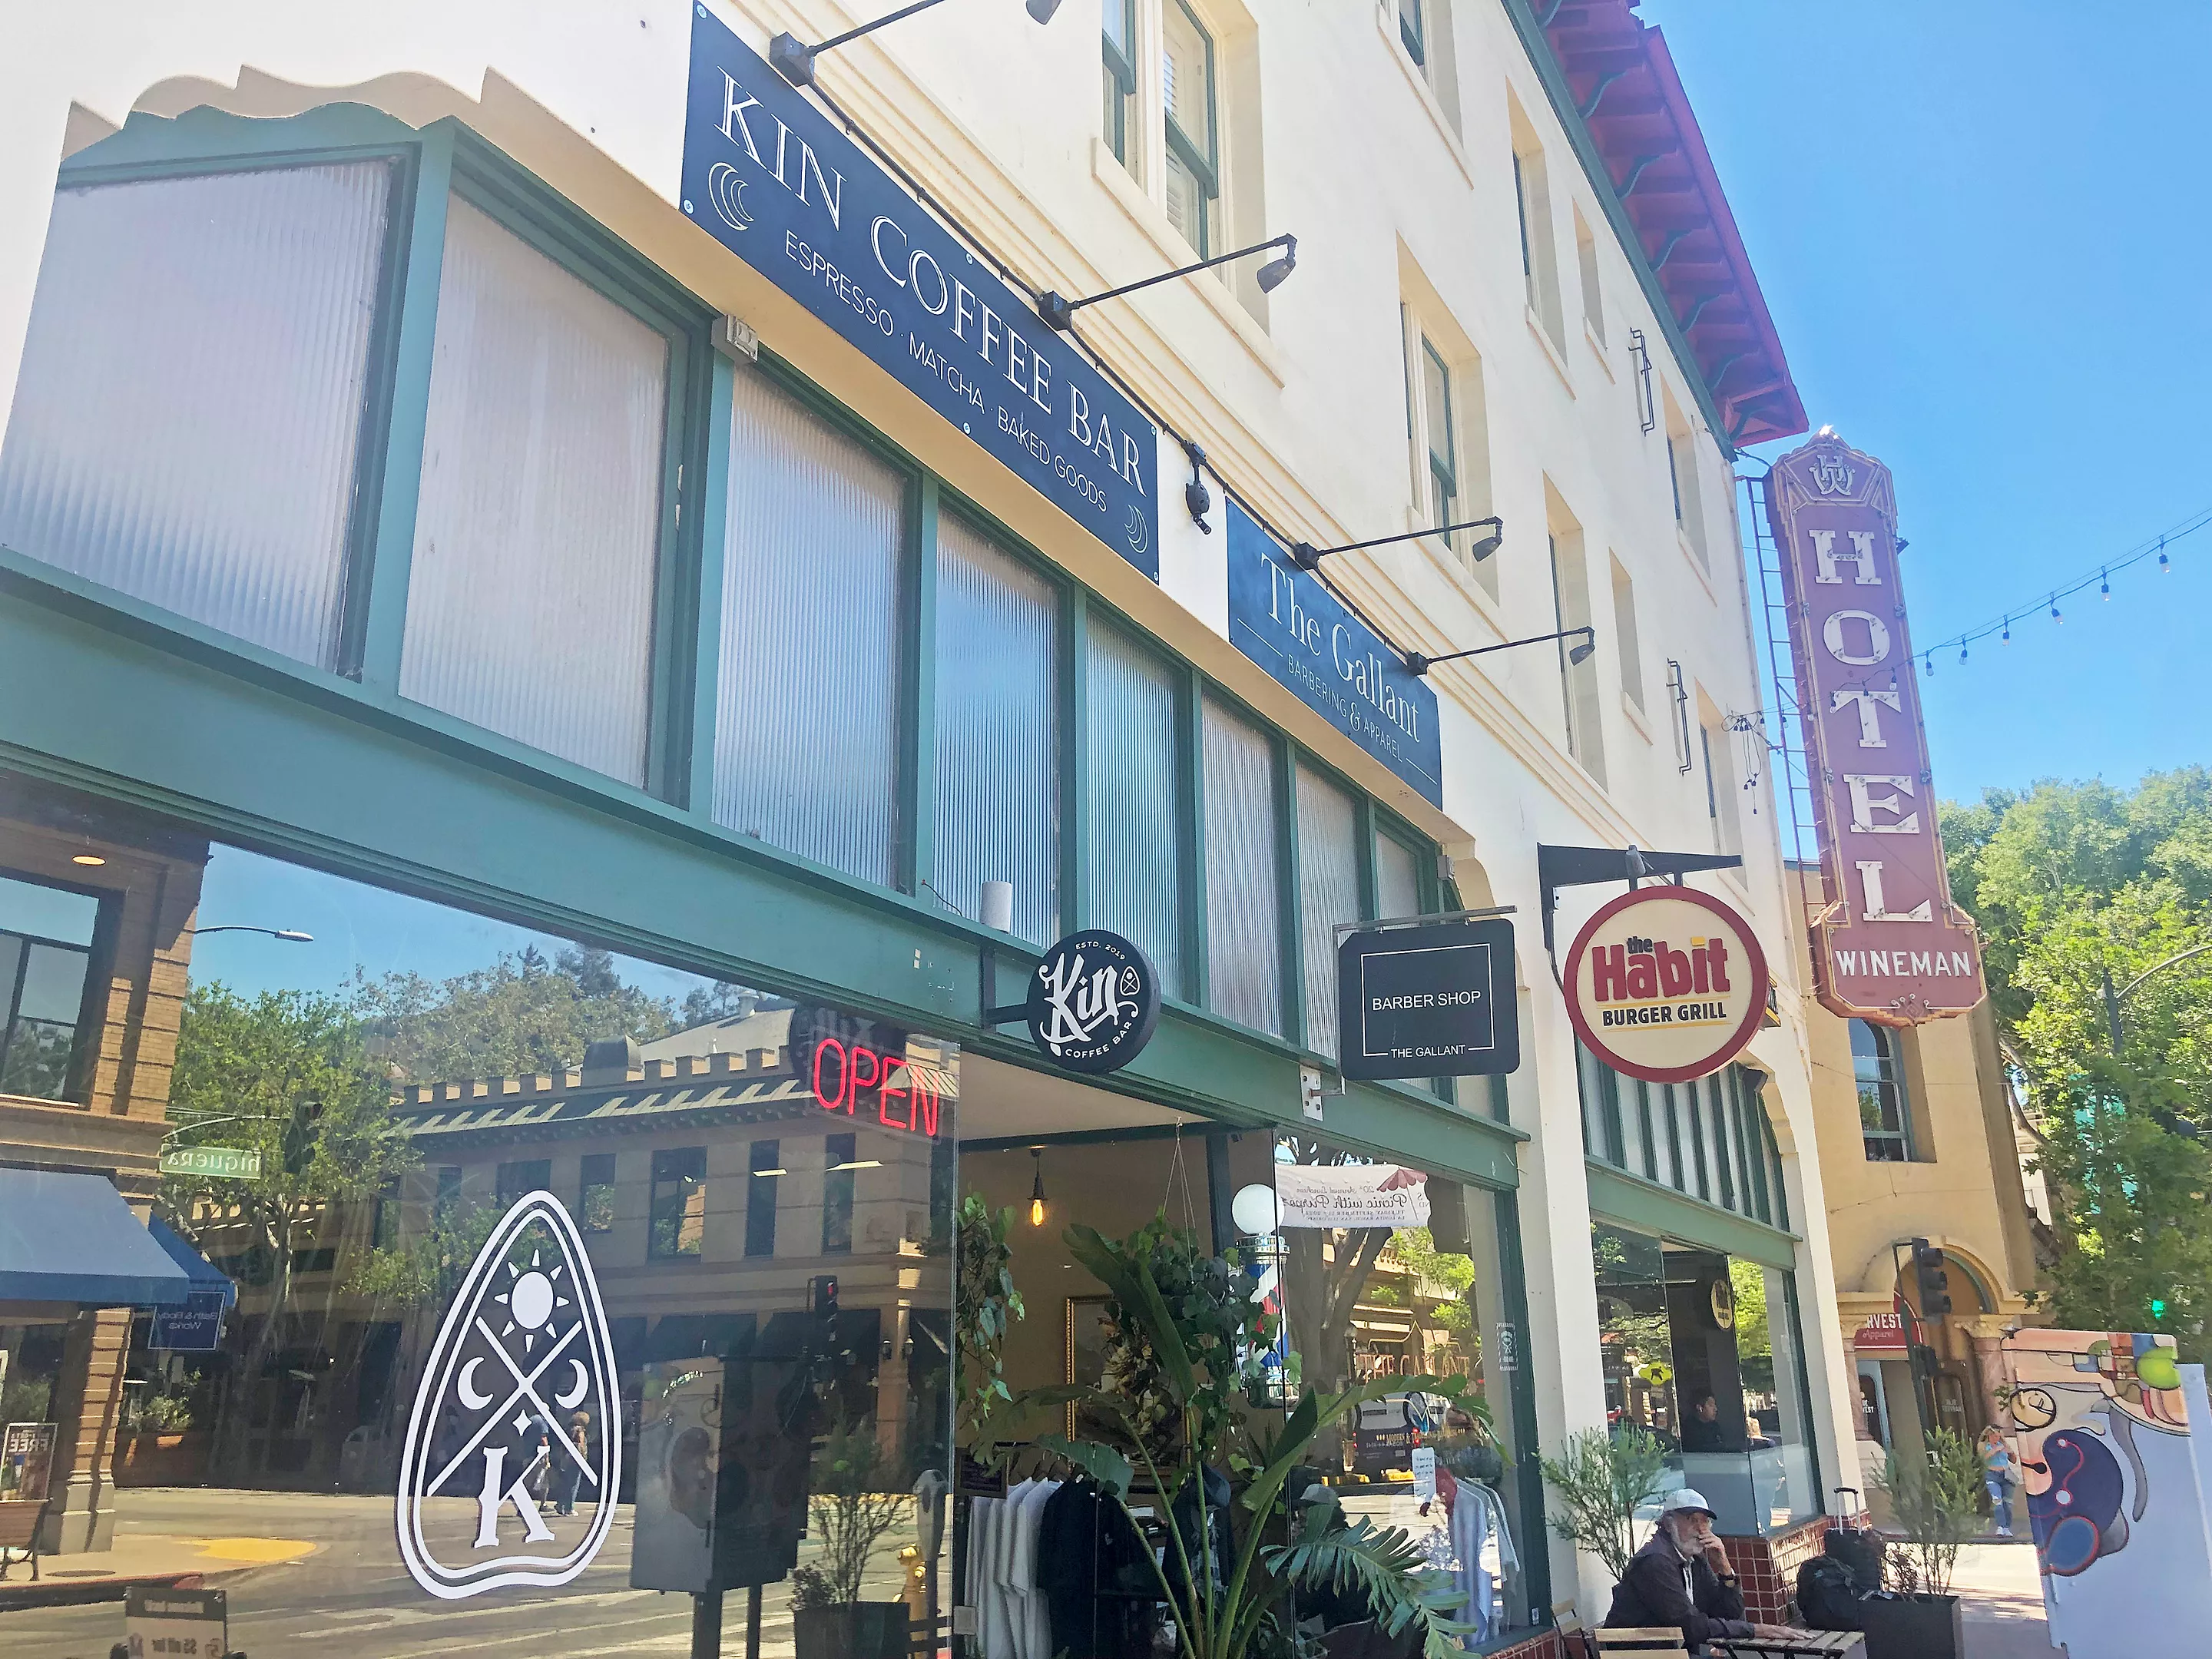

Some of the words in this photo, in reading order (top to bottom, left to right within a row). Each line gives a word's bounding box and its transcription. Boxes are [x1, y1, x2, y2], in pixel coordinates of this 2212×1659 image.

[714, 66, 846, 231] KIN
[870, 215, 1053, 415] COFFEE
[1066, 379, 1147, 498] BAR
[785, 230, 894, 336] ESPRESSO
[909, 332, 985, 415] MATCHA
[998, 405, 1051, 466] BAKED
[1055, 452, 1107, 513] GOODS
[1260, 551, 1322, 657] The
[1332, 623, 1421, 743] Gallant
[1288, 654, 1347, 717] BARBERING
[1350, 701, 1361, 732] &
[1363, 717, 1403, 763] APPAREL
[1809, 529, 1933, 922] HOTEL
[1075, 941, 1101, 950] ESTD.
[1104, 944, 1126, 961] 2019
[1591, 935, 1730, 1002] Habit
[1626, 935, 1653, 954] the
[1835, 950, 1972, 978] WINEMAN
[1038, 952, 1123, 1043] Kin
[1372, 994, 1435, 1011] BARBER
[1437, 990, 1481, 1006] SHOP
[1602, 1005, 1673, 1027] BURGER
[1677, 1002, 1727, 1022] GRILL
[1065, 1042, 1111, 1058] COFFEE
[1111, 1021, 1133, 1045] BAR
[1390, 1048, 1413, 1058] THE
[1416, 1045, 1466, 1058] GALLANT
[813, 1038, 940, 1137] OPEN
[1863, 1330, 1894, 1340] Apparel
